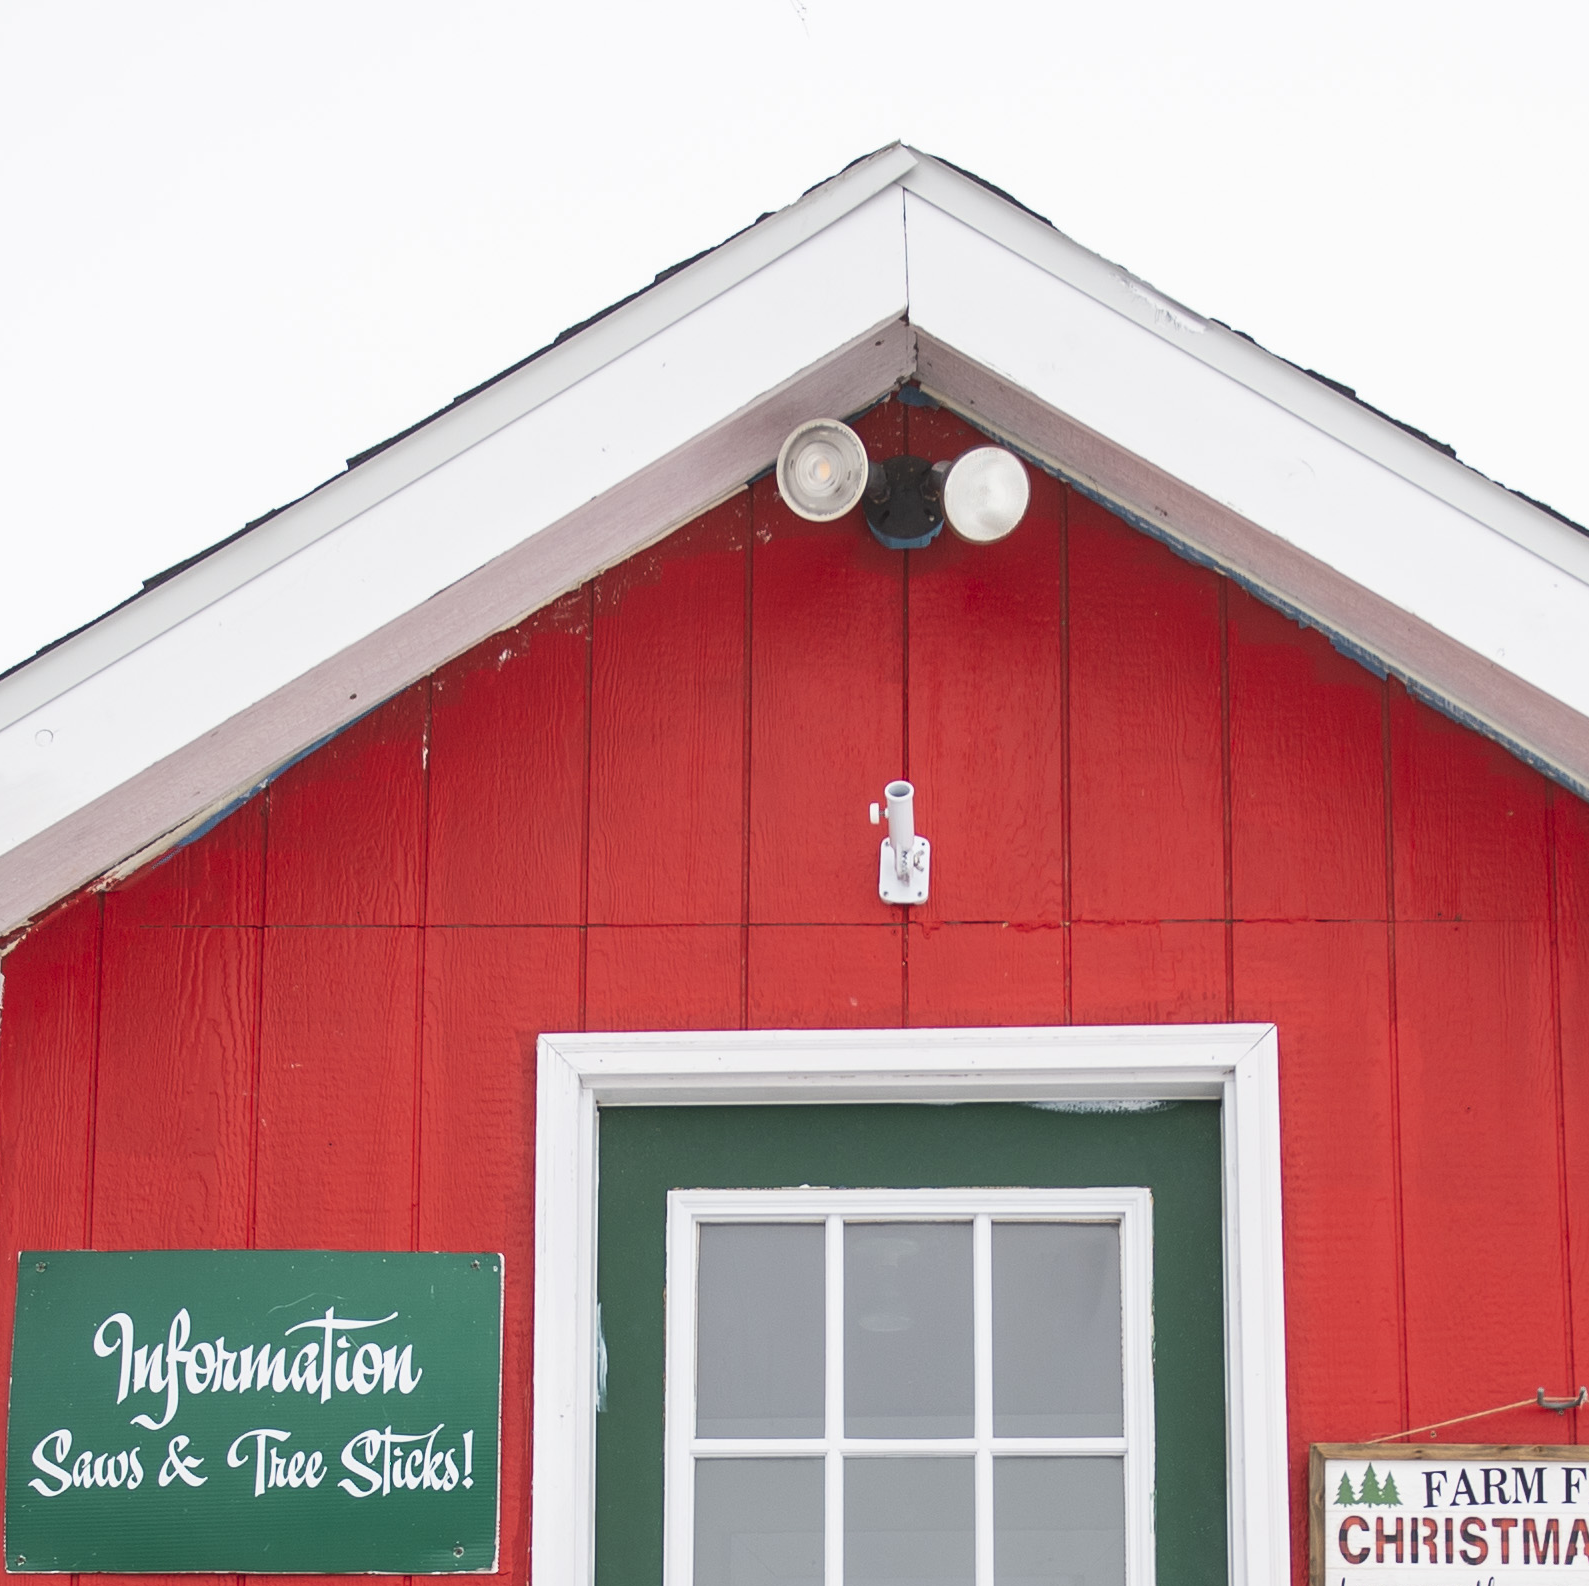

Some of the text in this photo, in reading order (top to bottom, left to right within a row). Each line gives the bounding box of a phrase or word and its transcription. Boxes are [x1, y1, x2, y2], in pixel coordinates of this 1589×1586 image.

[94, 1307, 422, 1430] Information
[28, 1424, 473, 1497] Saws & Tree Sticks!
[1422, 1467, 1547, 1508] FARM
